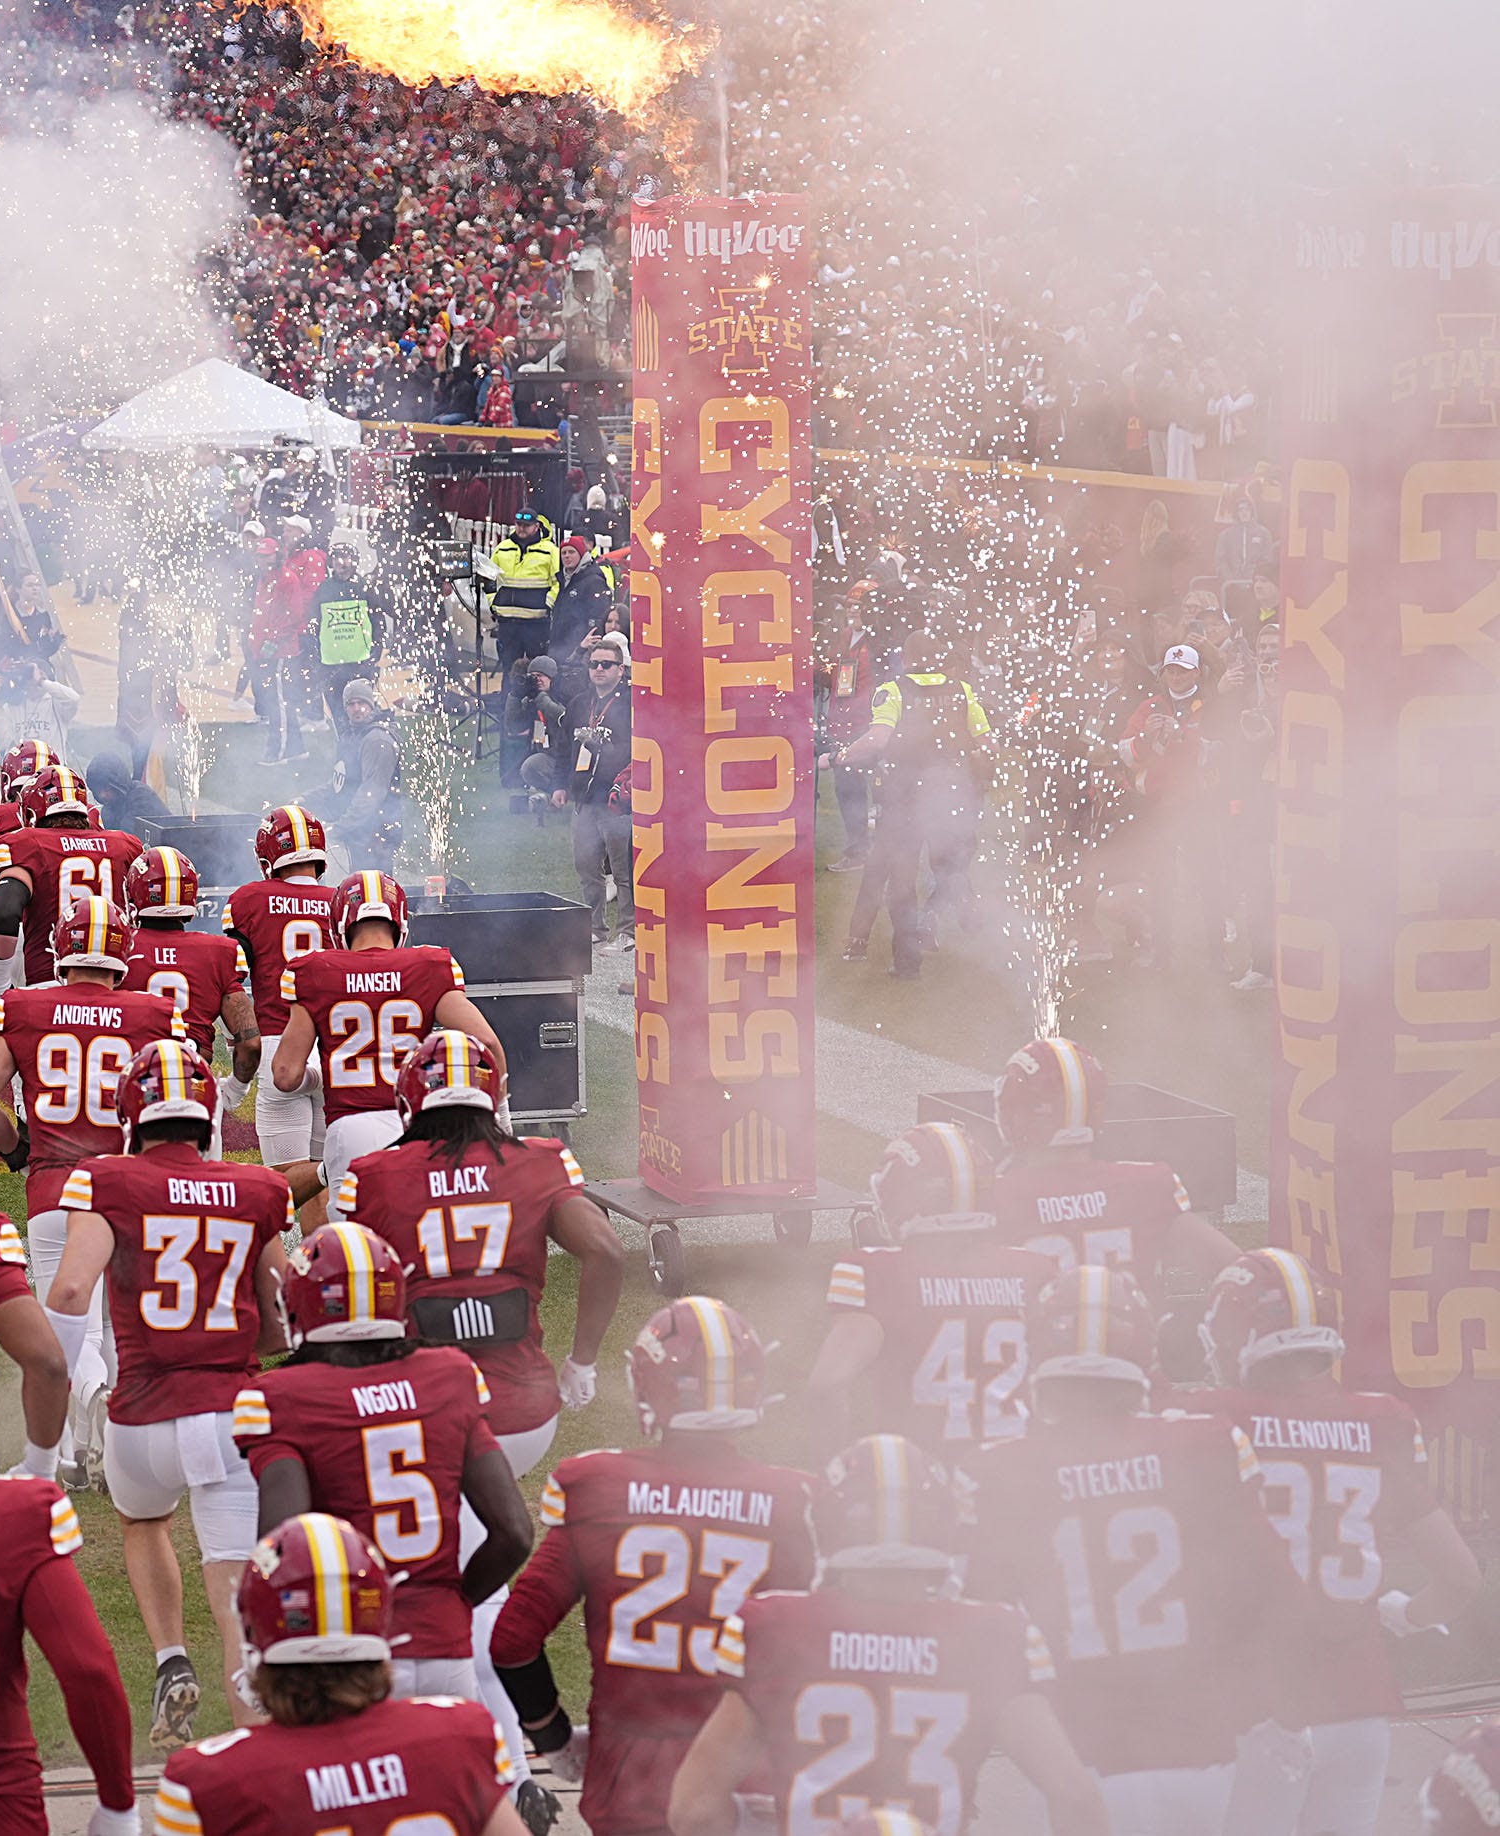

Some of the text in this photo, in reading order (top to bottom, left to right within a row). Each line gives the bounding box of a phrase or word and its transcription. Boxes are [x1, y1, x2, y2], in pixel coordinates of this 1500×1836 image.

[631, 222, 669, 266] yVee
[684, 220, 801, 265] HyVee
[1390, 221, 1500, 280] HyV
[688, 315, 803, 355] STATE
[1393, 346, 1500, 403] STA
[699, 397, 801, 1084] CYCLONES
[60, 837, 107, 853] BARRETT
[58, 856, 113, 915] 61
[269, 896, 331, 916] ESKILDSEN
[154, 948, 177, 965] LEE
[346, 971, 401, 993] HANSEN
[52, 1003, 123, 1029] ANDREWS
[329, 999, 423, 1089] 26
[34, 1032, 133, 1127] 96
[168, 1177, 236, 1208] BENETTI
[428, 1165, 490, 1198] BLACK
[1037, 1190, 1107, 1224] ROSKOP
[416, 1201, 513, 1279] 17
[140, 1214, 256, 1332] 37
[919, 1276, 1026, 1307] HAWTHORNE
[351, 1379, 417, 1418] NGOYI
[912, 1318, 1028, 1440] 42
[1251, 1416, 1371, 1454] ZELENOVICH
[361, 1420, 443, 1562] 5
[1058, 1454, 1163, 1502] STECKER
[628, 1481, 773, 1527] McLAUGHLIN
[1053, 1506, 1189, 1660] 12
[830, 1631, 939, 1676] ROBBINS
[786, 1682, 970, 1836] 23
[305, 1753, 408, 1812] MILLER
